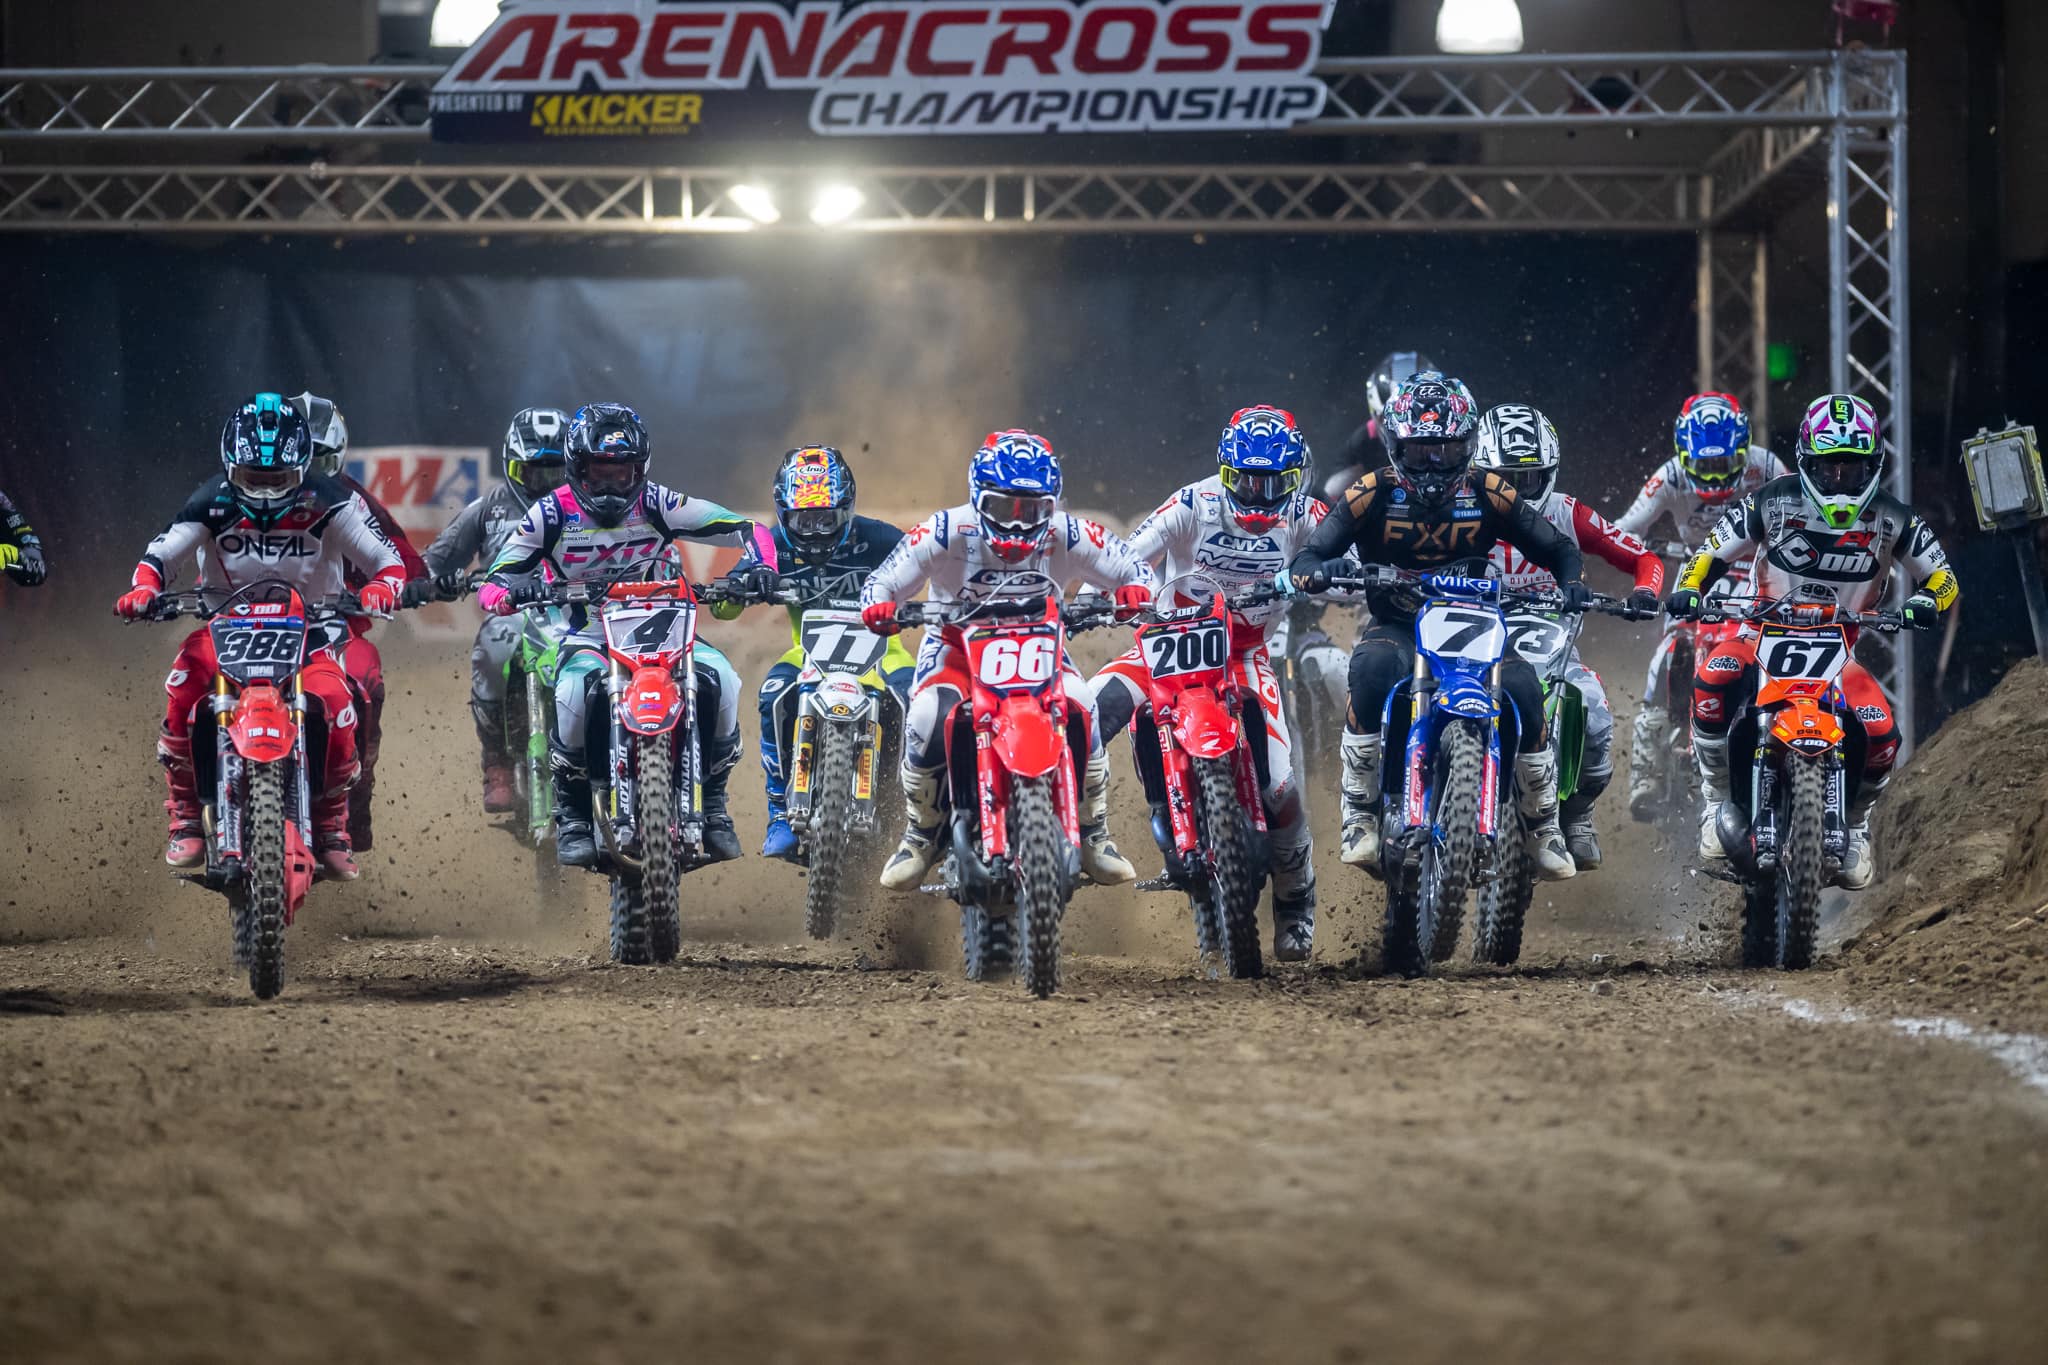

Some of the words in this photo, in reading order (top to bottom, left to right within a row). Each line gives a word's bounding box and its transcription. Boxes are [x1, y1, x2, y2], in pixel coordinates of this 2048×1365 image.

[454, 4, 1323, 82] ARENACROSS
[429, 95, 500, 112] PRESENTED
[506, 94, 524, 112] BY
[561, 94, 703, 125] KICKER
[817, 86, 1319, 126] CHAMPIONSHIP
[800, 465, 825, 474] Arai
[1243, 457, 1272, 466] Arai
[1384, 520, 1482, 550] FXR
[563, 537, 661, 569] FXR
[1196, 548, 1284, 574] MCR
[620, 608, 680, 653] 4
[1436, 611, 1497, 652] 7
[1701, 614, 1722, 622] ASV
[1878, 623, 1900, 631] ASV
[219, 629, 302, 665] 388
[806, 623, 881, 665] 11
[1151, 629, 1224, 678] 200
[1502, 619, 1562, 654] 73
[980, 637, 1056, 686] 66
[1767, 640, 1842, 677] 67
[1458, 704, 1489, 714] YAMAHA
[618, 744, 630, 815] DULOP
[681, 746, 690, 815] DUNLOP
